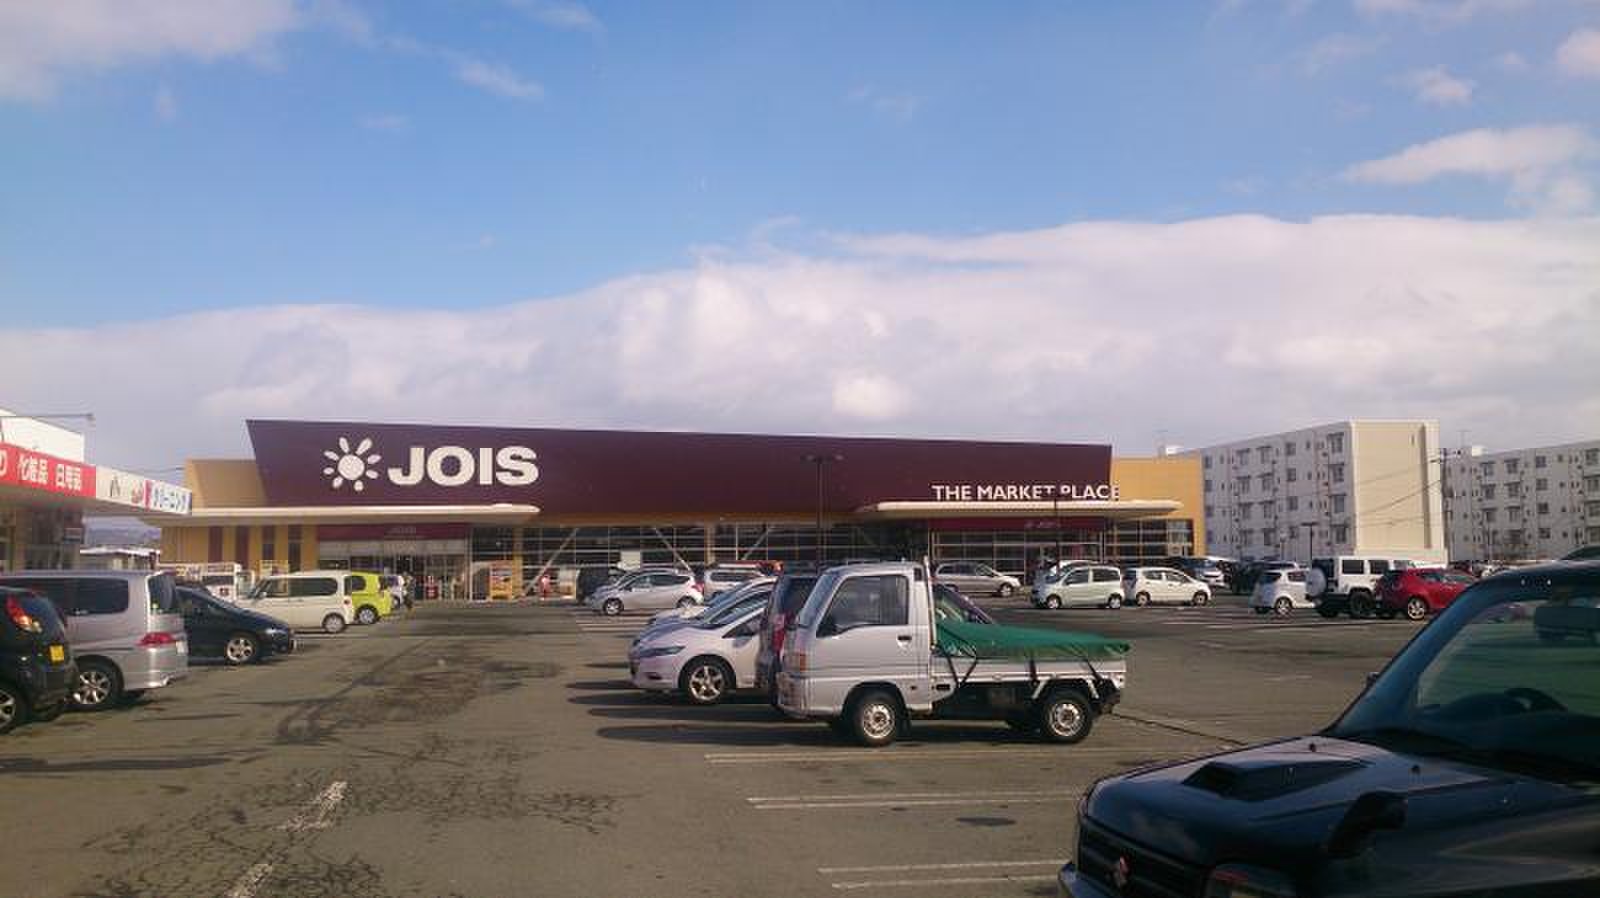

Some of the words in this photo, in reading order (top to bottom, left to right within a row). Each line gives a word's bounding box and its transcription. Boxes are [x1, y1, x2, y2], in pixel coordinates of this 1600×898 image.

[387, 445, 539, 486] JOIS
[931, 484, 972, 500] THE
[976, 484, 1056, 500] MARKET
[1060, 484, 1120, 500] PLACE
